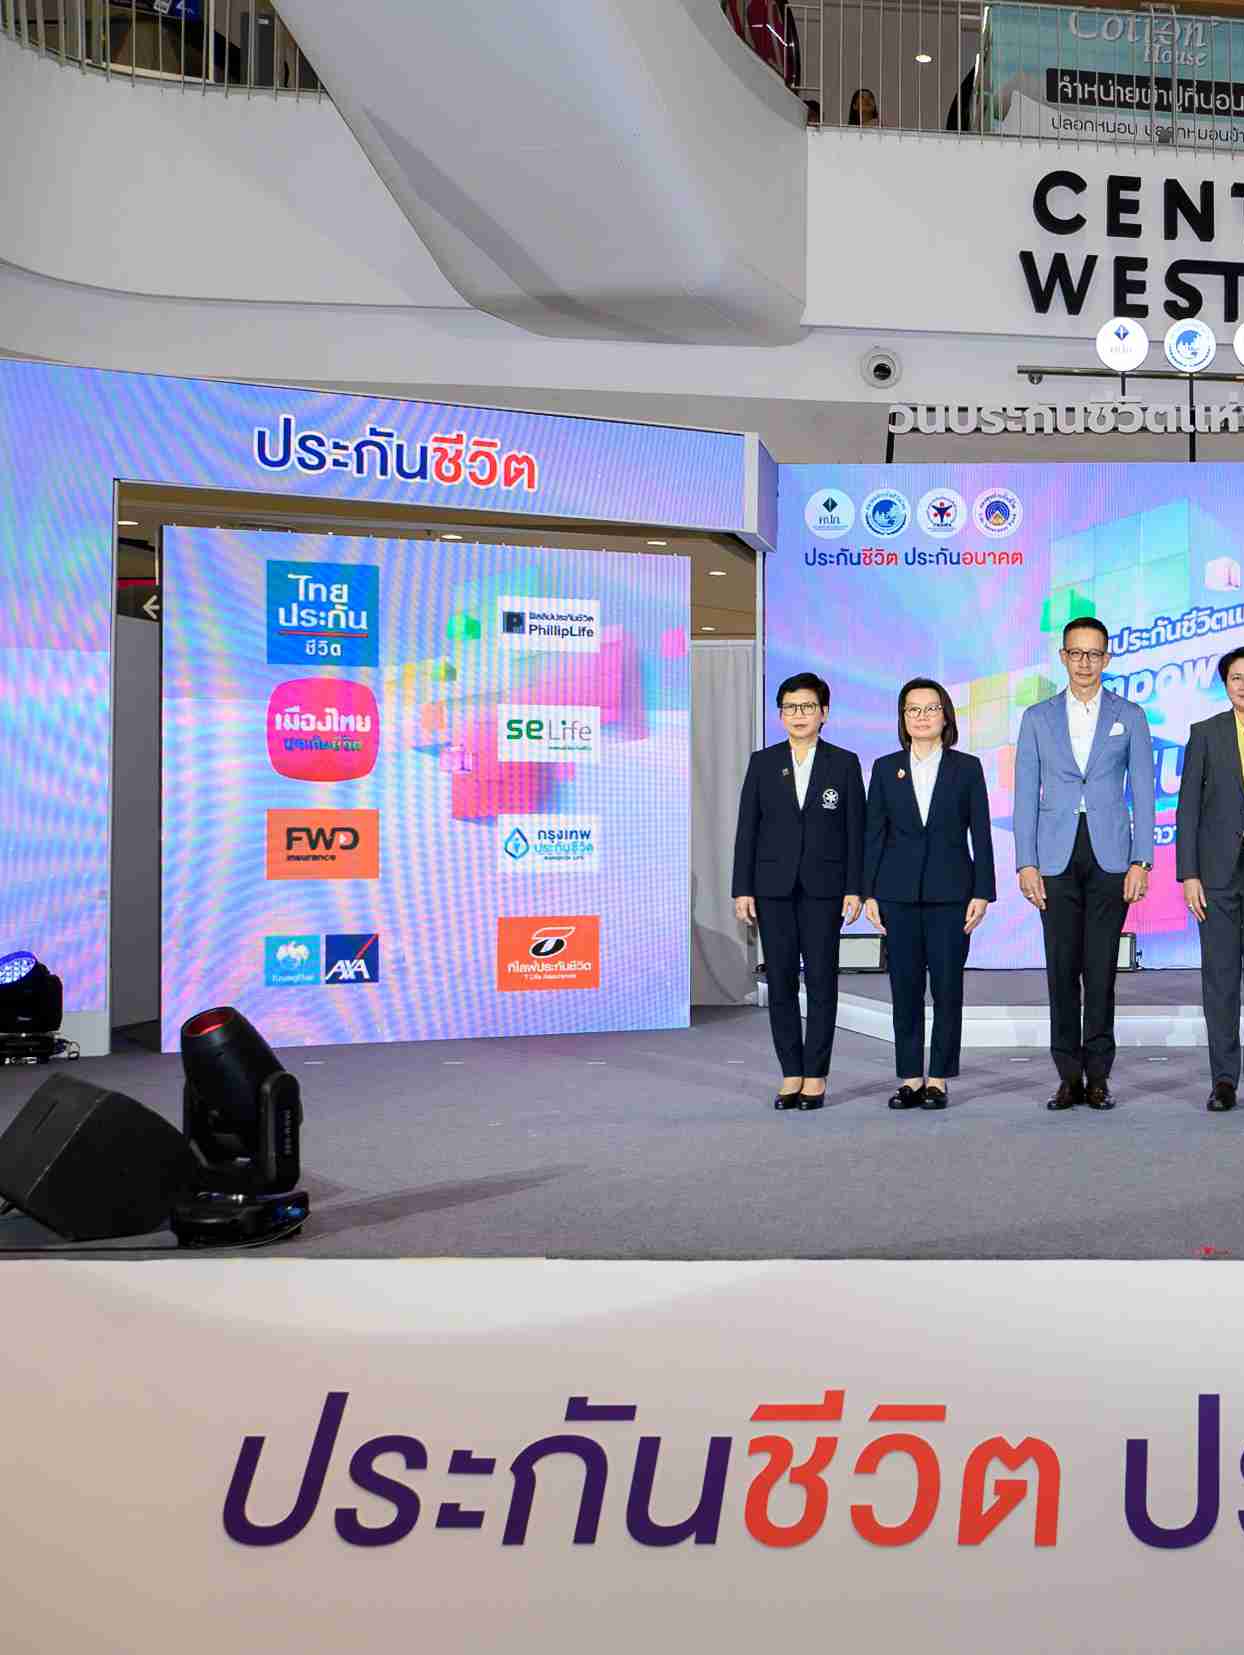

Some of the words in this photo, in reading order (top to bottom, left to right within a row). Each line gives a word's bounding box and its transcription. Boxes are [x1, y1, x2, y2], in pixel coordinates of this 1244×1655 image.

[256, 417, 537, 489] ประกันชีวิต
[804, 547, 898, 566] ประกันชีวิต
[904, 547, 1024, 566] ประกันอนาคต
[288, 574, 348, 603] ไทย
[278, 602, 368, 630] ประกัน
[529, 624, 594, 638] PhillipLife
[305, 639, 342, 657] ชีวิต
[274, 706, 372, 733] เมืองไทย
[286, 827, 359, 851] FWD
[537, 829, 591, 844] กรุงเทพ
[325, 958, 371, 980] AXA
[221, 1390, 1062, 1549] ประกันชีวิต
